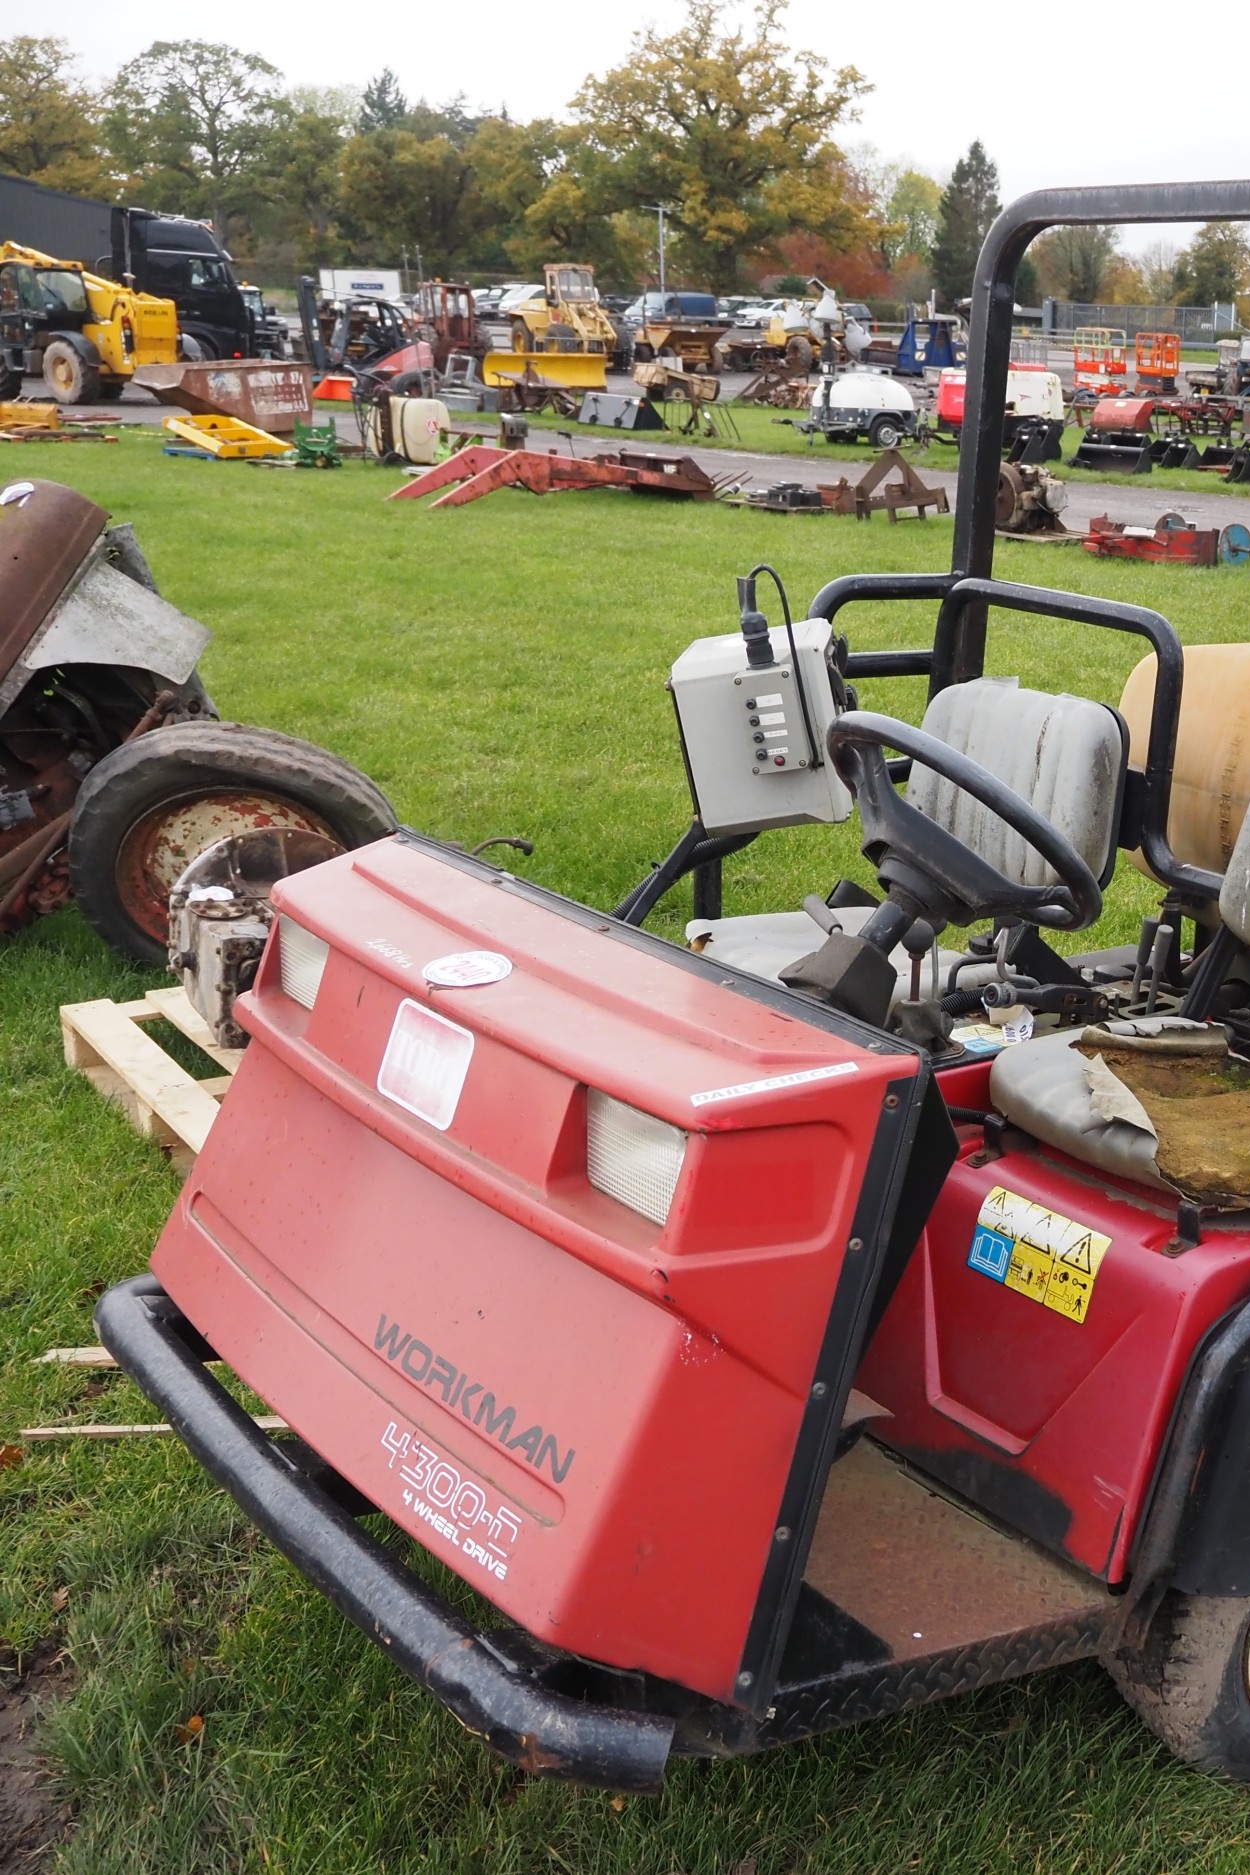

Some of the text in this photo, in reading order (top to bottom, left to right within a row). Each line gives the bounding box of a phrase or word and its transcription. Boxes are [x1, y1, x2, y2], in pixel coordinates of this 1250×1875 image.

[694, 1064, 854, 1103] DAILY CHECKS
[374, 1313, 576, 1483] WORKMAN
[402, 1489, 508, 1581] 4 WHEEL DRIVE
